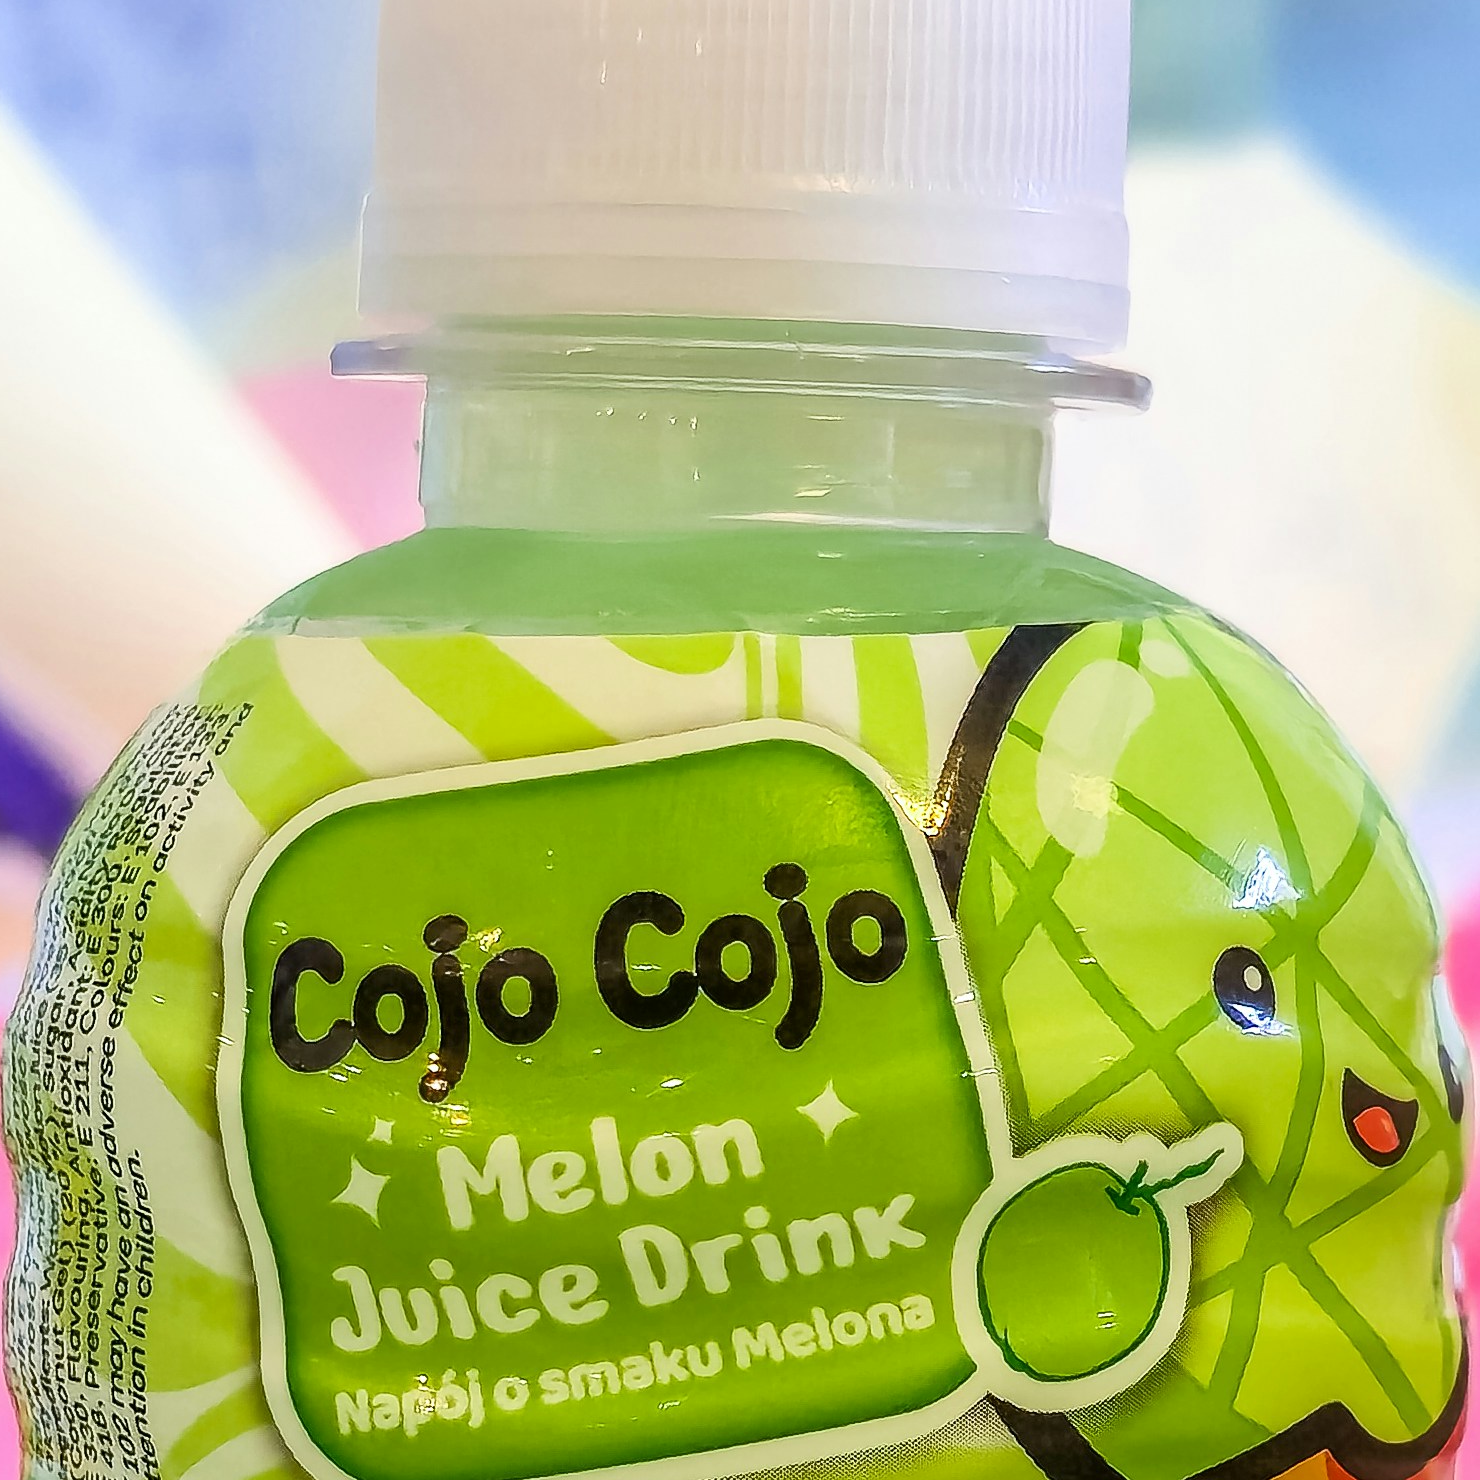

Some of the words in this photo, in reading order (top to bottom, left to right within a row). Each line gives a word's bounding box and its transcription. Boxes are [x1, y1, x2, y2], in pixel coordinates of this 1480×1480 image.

[213, 701, 254, 756] and
[134, 794, 178, 857] 102,
[152, 759, 214, 873] activity
[133, 879, 157, 922] on
[78, 893, 128, 1035] Colours:
[107, 928, 144, 1029] effect
[269, 913, 560, 1104] Cojo
[594, 861, 909, 1050] Cojo
[73, 1045, 93, 1117] 211,
[98, 1035, 122, 1178] adverse
[75, 1125, 93, 1147] E
[436, 1116, 765, 1230] Melon
[113, 1184, 131, 1230] an
[127, 1149, 154, 1298] children.
[84, 1158, 108, 1389] Preservative:
[105, 1235, 132, 1322] have
[330, 1258, 610, 1352] Juice
[618, 1192, 927, 1307] Drink
[126, 1305, 148, 1339] in
[109, 1324, 130, 1408] may
[334, 1368, 485, 1438] Napój
[493, 1375, 529, 1411] o
[538, 1341, 724, 1406] smaku
[731, 1293, 935, 1370] Melona
[72, 1393, 98, 1463] 330,
[90, 1399, 114, 1469] 418,
[111, 1412, 139, 1474] 102
